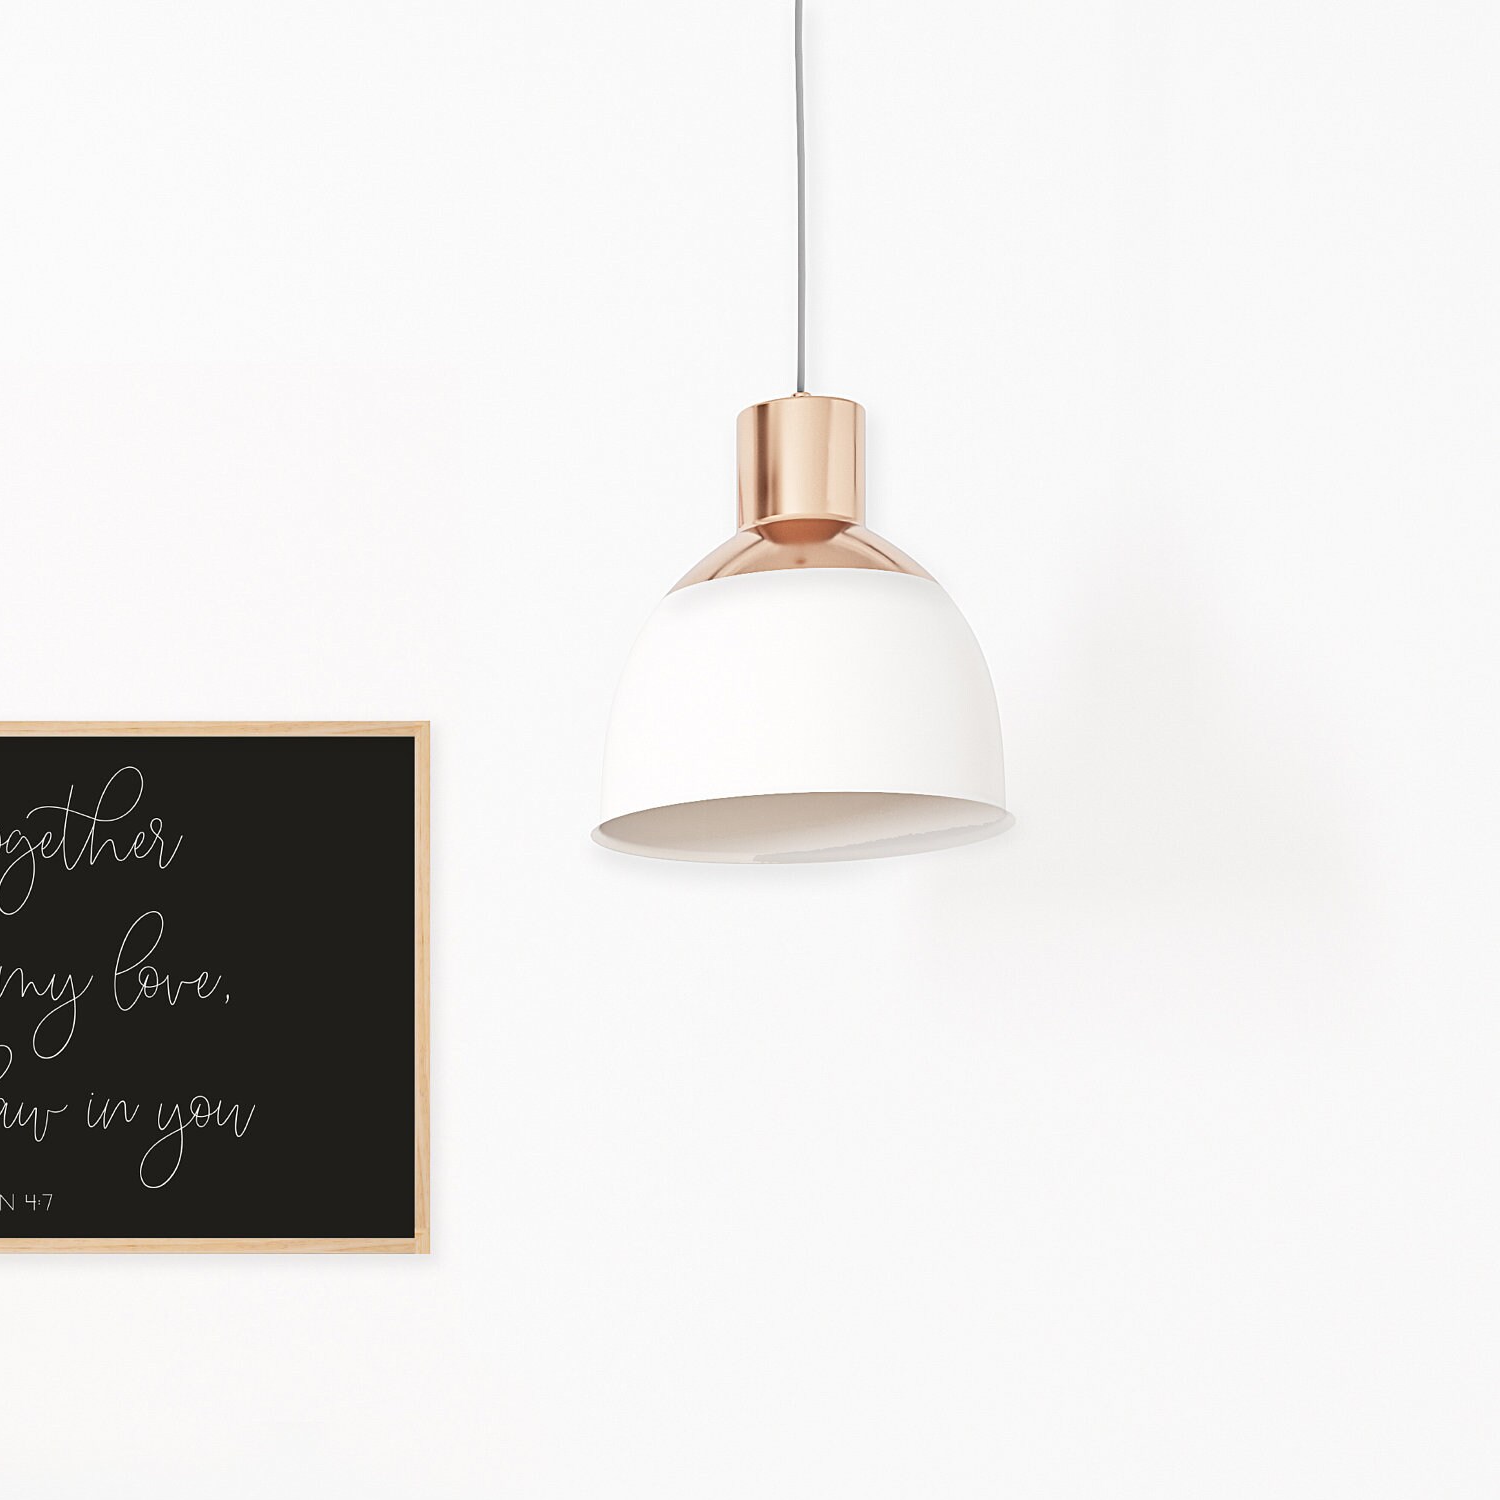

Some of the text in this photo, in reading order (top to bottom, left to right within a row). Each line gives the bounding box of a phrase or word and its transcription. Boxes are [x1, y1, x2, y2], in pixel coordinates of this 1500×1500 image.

[113, 910, 232, 1012] love,
[87, 1091, 140, 1130] in
[139, 1095, 256, 1189] you
[25, 1193, 53, 1212] 4:7
